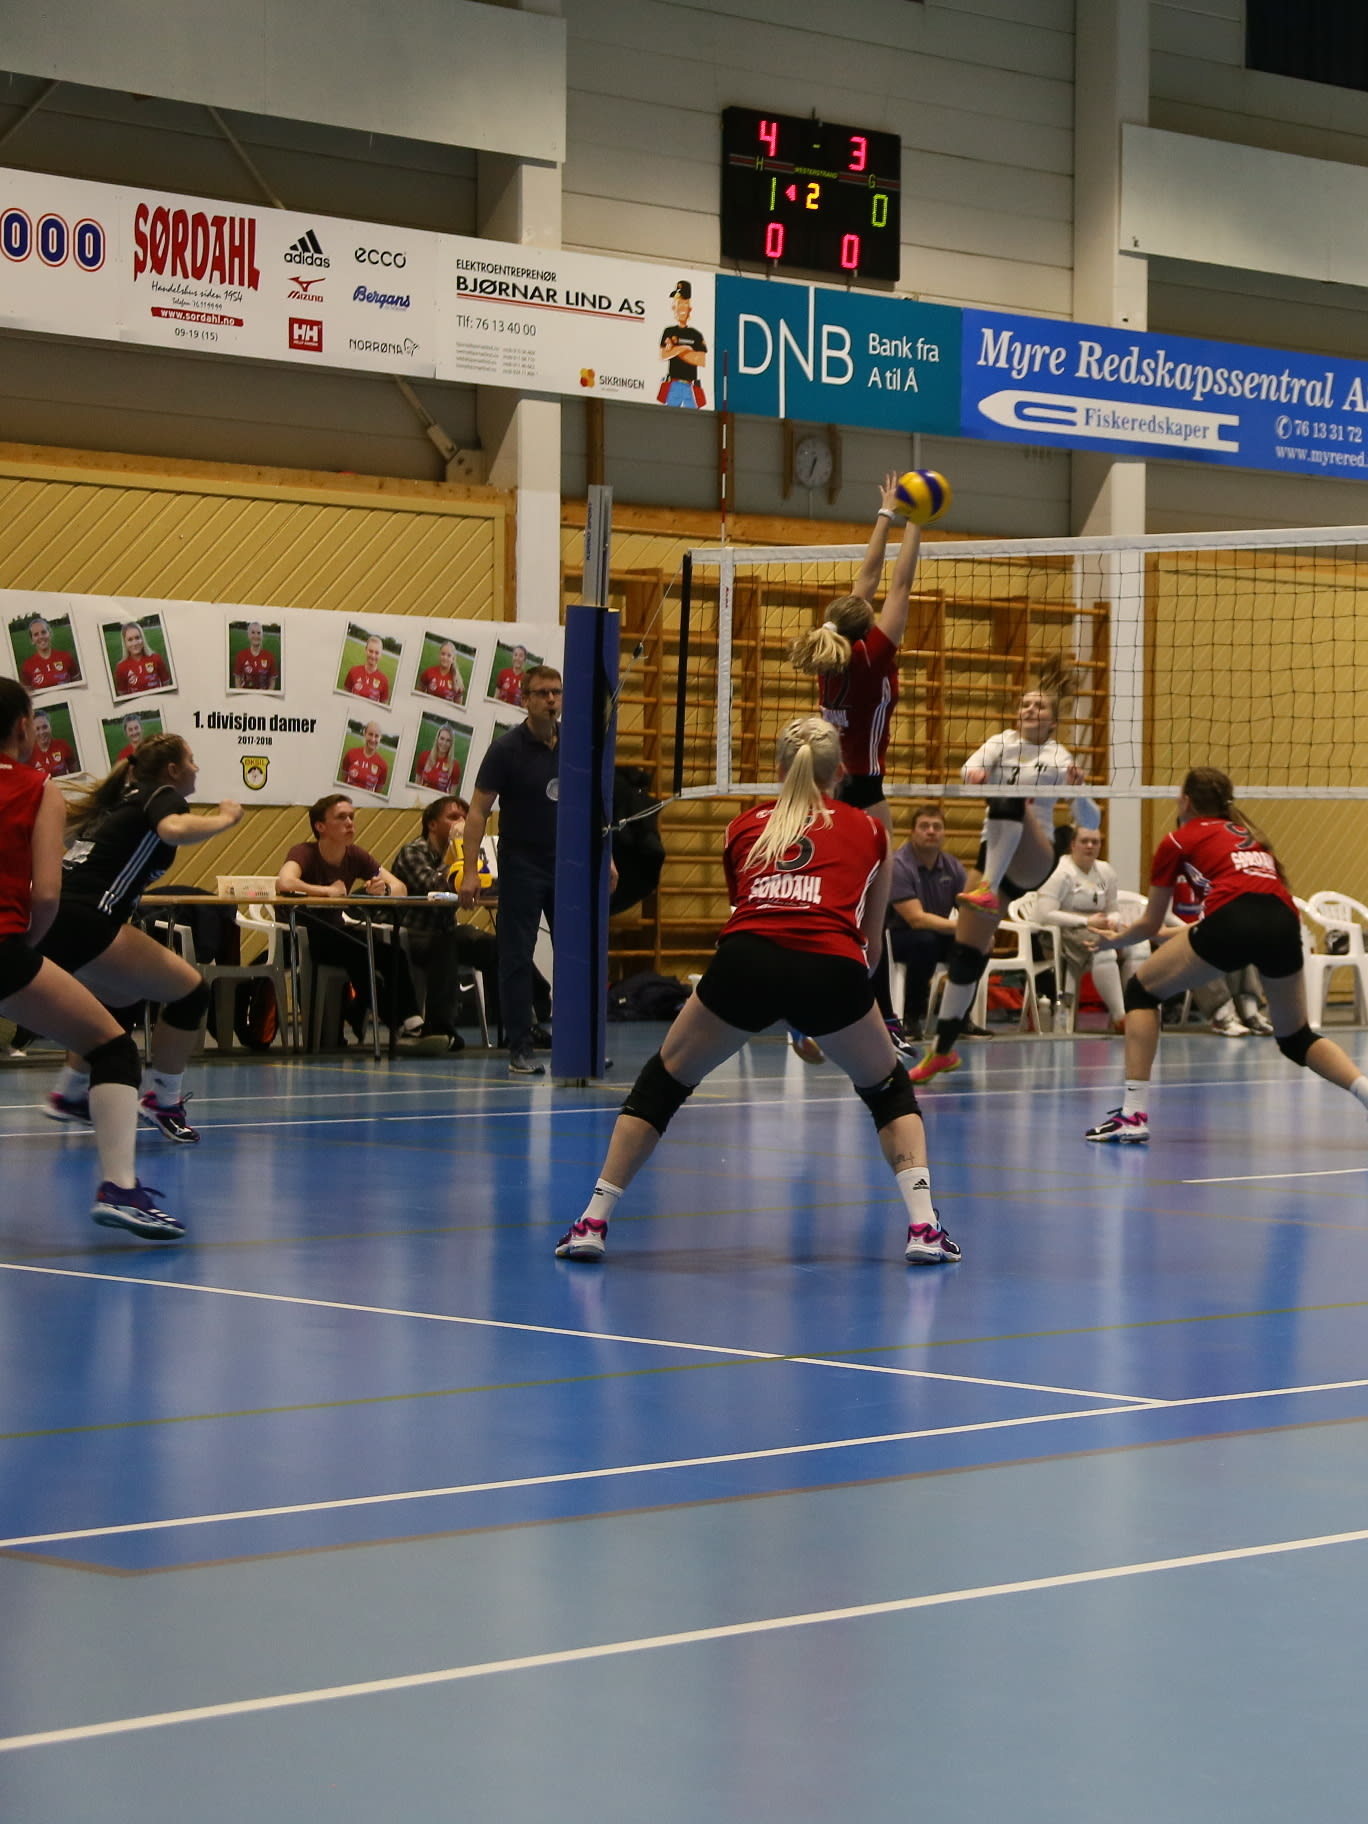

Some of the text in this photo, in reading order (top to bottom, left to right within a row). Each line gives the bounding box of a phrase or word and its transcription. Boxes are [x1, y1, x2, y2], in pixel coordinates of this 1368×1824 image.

[759, 120, 867, 171] 4 3
[755, 156, 764, 171] H
[806, 183, 820, 210] 2
[872, 193, 888, 227] 0
[134, 203, 260, 291] SØRDAHL
[766, 223, 860, 268] 0 0
[284, 252, 330, 268] adidas
[355, 247, 406, 268] ecco
[456, 259, 557, 282] ELEKTROENTREPRENØR
[224, 290, 243, 303] 1954
[353, 285, 410, 309] Bergans
[456, 275, 645, 315] BJØRNAR LIND AS
[160, 309, 235, 326] www.sordahl.no
[456, 315, 537, 336] Tlf: 76 13 40 00
[201, 331, 218, 341] (15)
[349, 338, 404, 354] NORRØNA
[868, 332, 940, 362] Bank fra
[739, 286, 854, 418] DNB
[867, 366, 919, 393] A til Å
[976, 328, 1067, 379] Myre
[1074, 340, 1334, 409] Redskapssentral
[599, 375, 645, 390] SIKRINGEN
[1084, 407, 1210, 441] Fiskeredskaper
[1294, 420, 1362, 443] 76 13 31 72
[193, 711, 317, 733] 1. divisjon damer
[237, 735, 273, 745] 2017-2018
[748, 873, 822, 904] SØRDAHL
